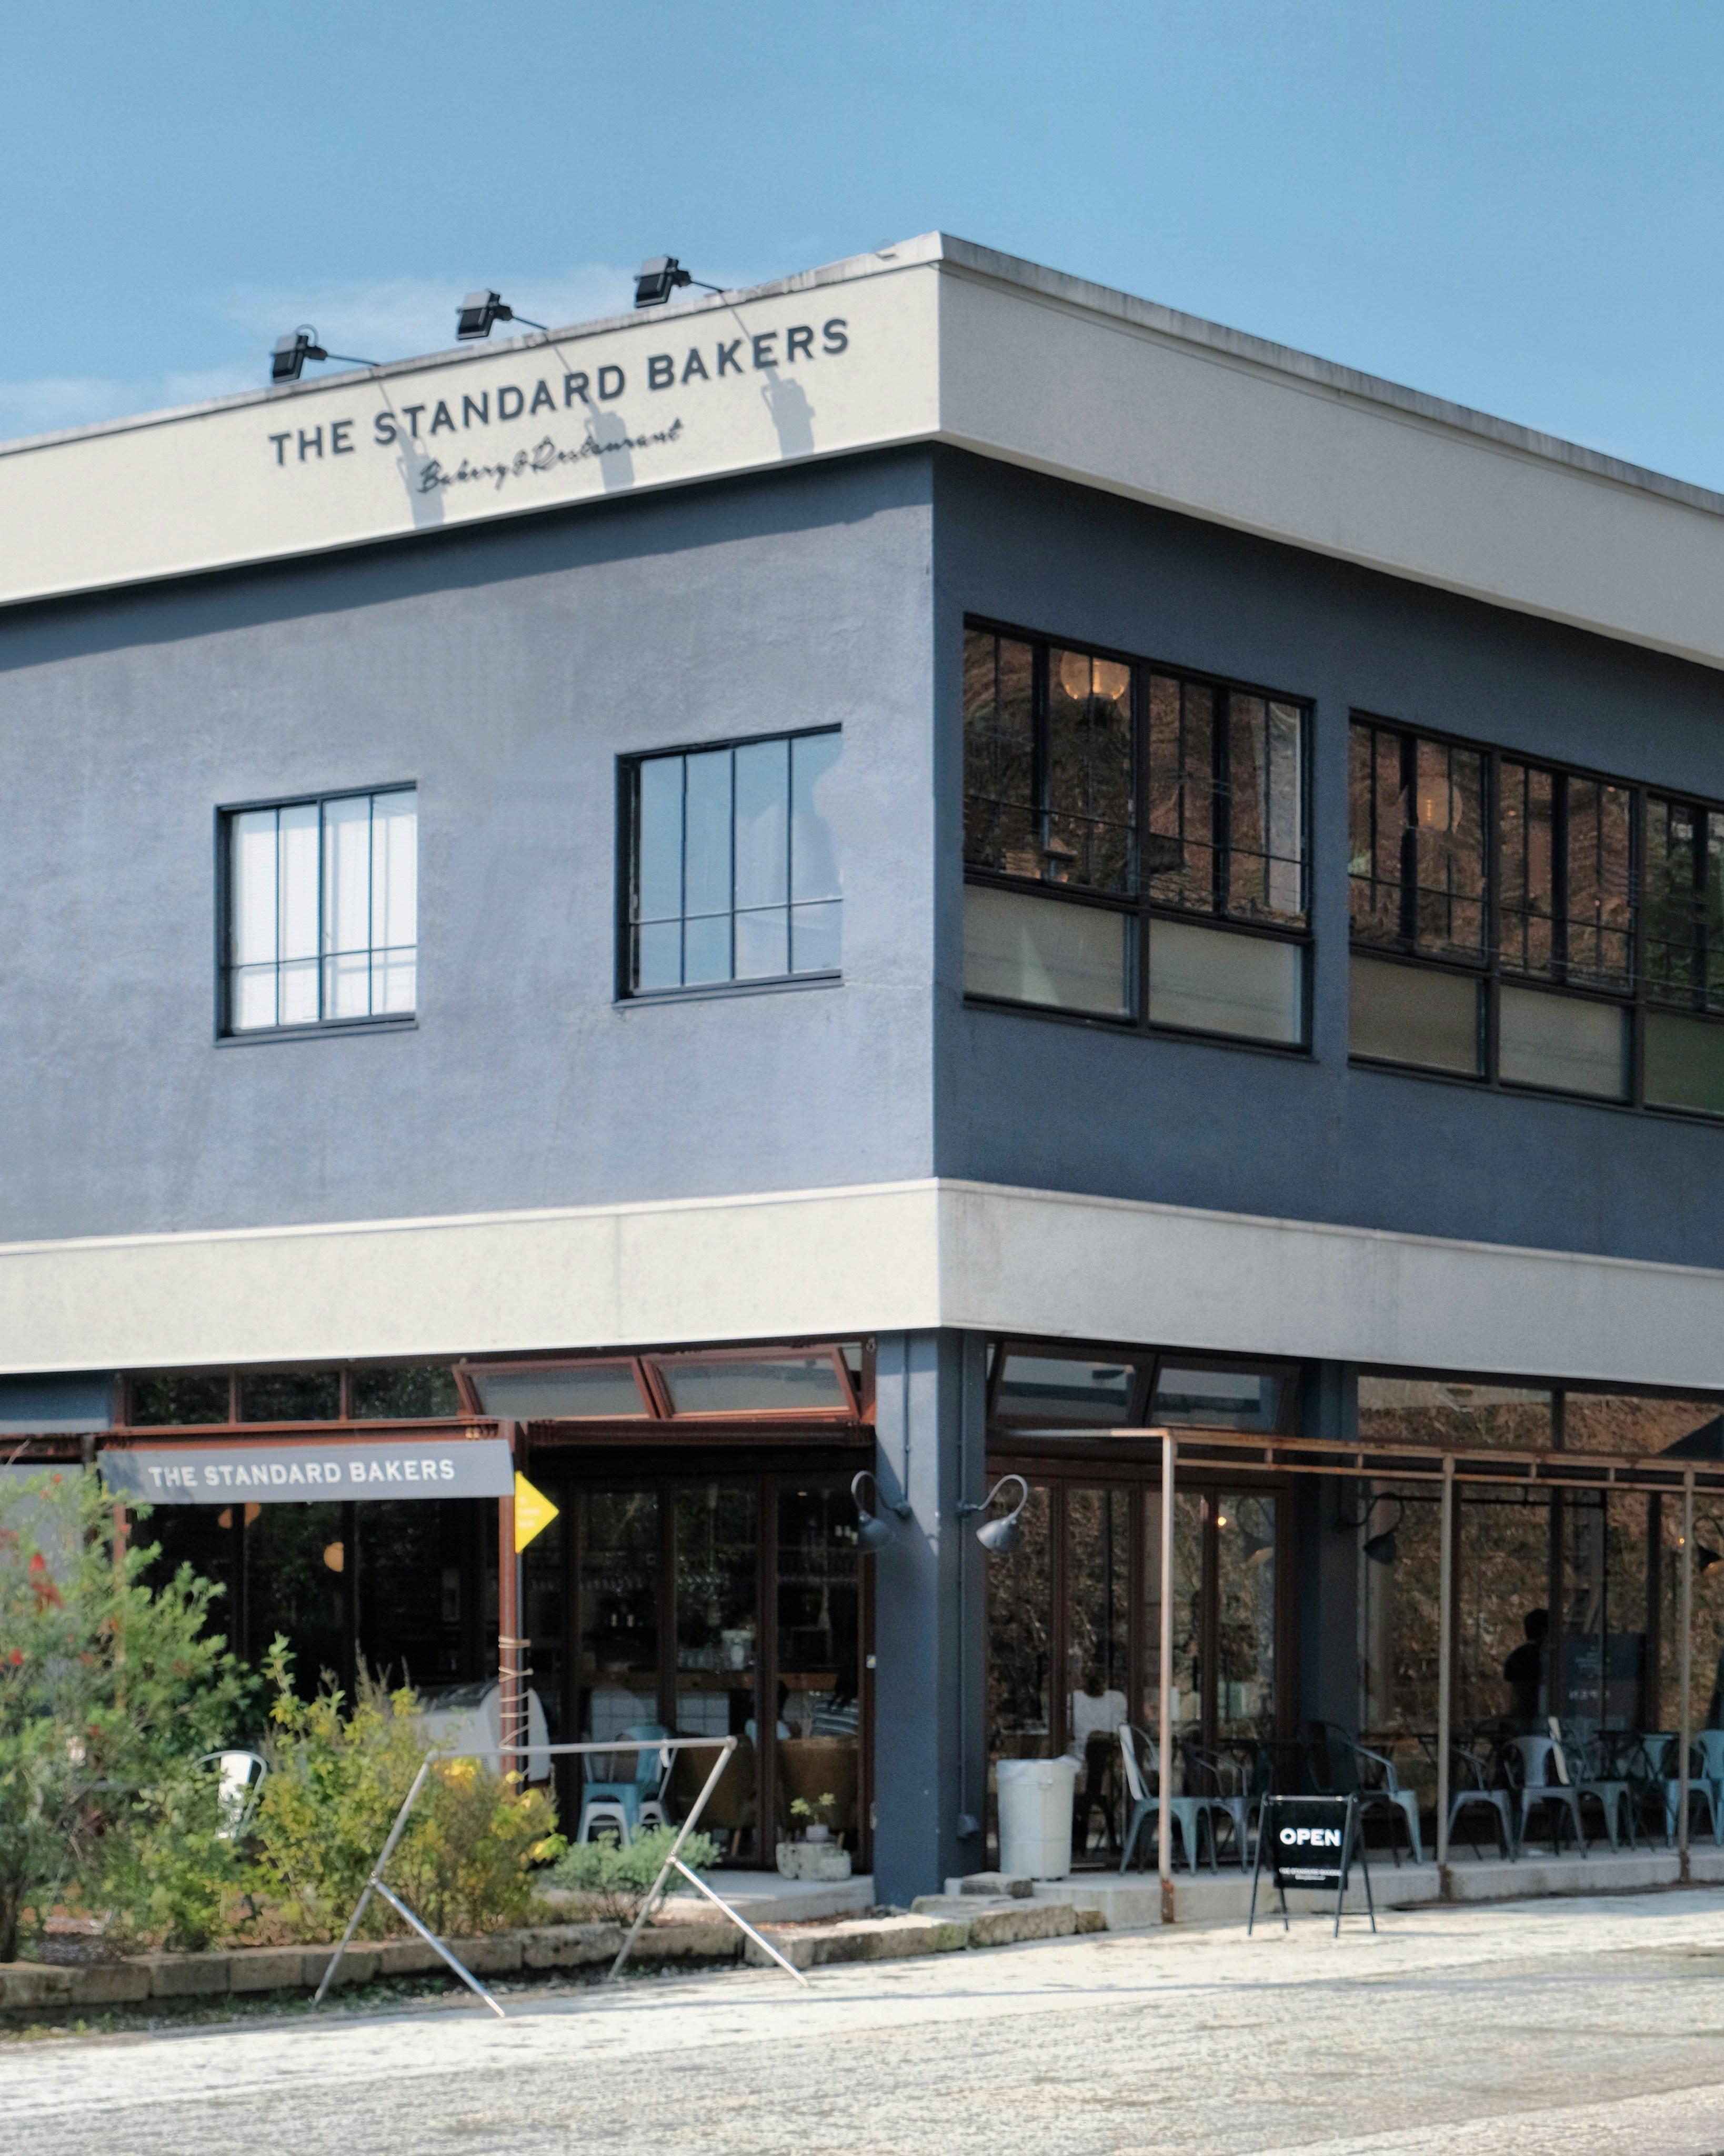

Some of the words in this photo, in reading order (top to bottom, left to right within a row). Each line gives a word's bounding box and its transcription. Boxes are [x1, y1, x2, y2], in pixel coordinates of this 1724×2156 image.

[268, 420, 355, 465] THE
[374, 365, 626, 446] STANDARD
[647, 318, 849, 391] BAKERS
[147, 1466, 198, 1488] THE
[203, 1462, 342, 1487] STANDARD
[348, 1458, 456, 1483] BAKERS
[1279, 1827, 1341, 1846] OPEN
